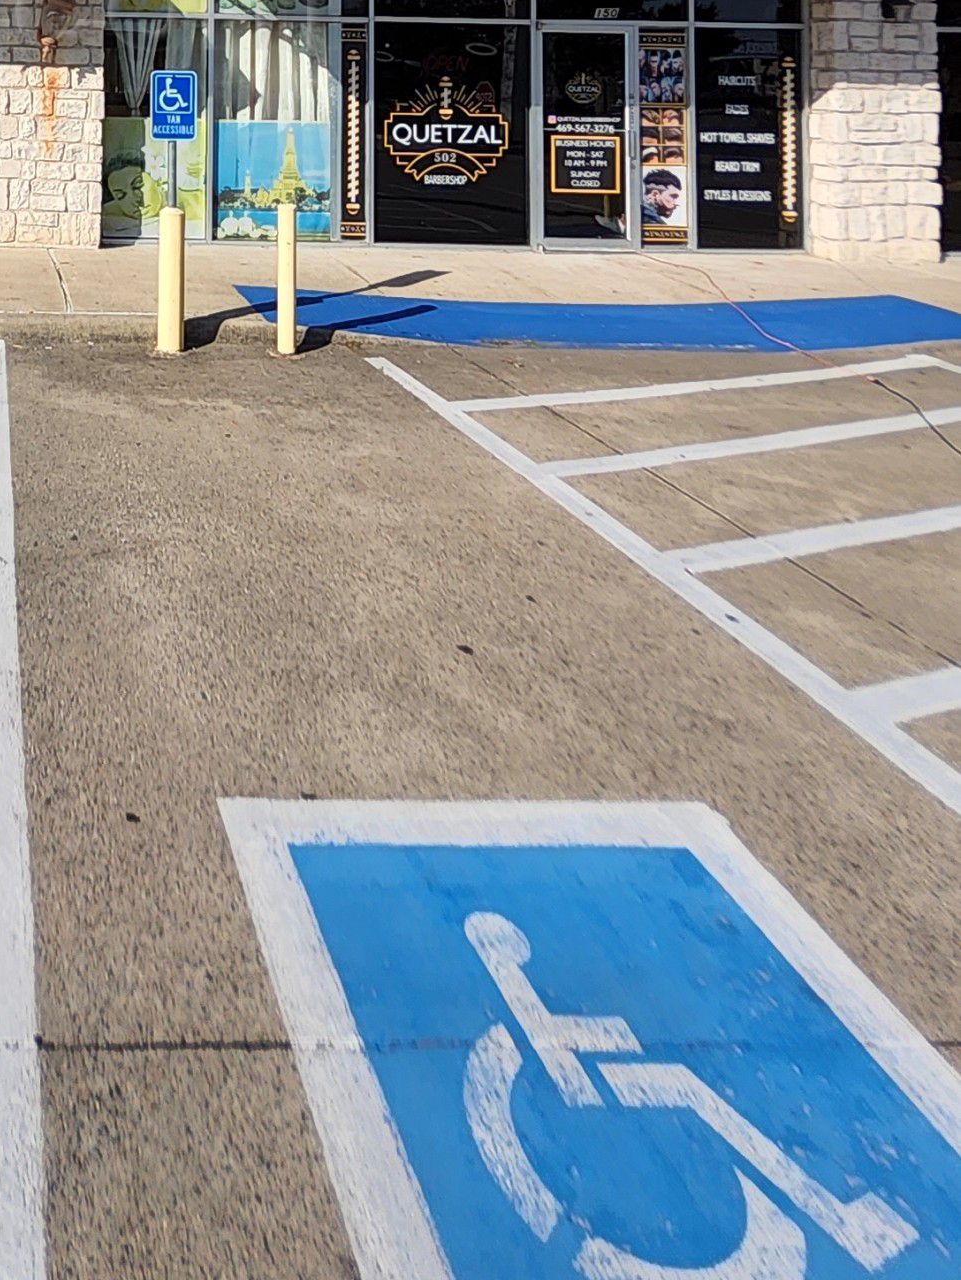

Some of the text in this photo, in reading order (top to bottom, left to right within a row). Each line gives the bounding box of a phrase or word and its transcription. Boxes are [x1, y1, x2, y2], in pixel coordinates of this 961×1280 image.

[597, 8, 618, 18] 150
[167, 115, 181, 124] VAN
[153, 125, 194, 135] ACCESSIBLE
[392, 123, 503, 146] QUETZAL
[434, 153, 457, 163] 502
[424, 174, 468, 185] BARBERSHOP
